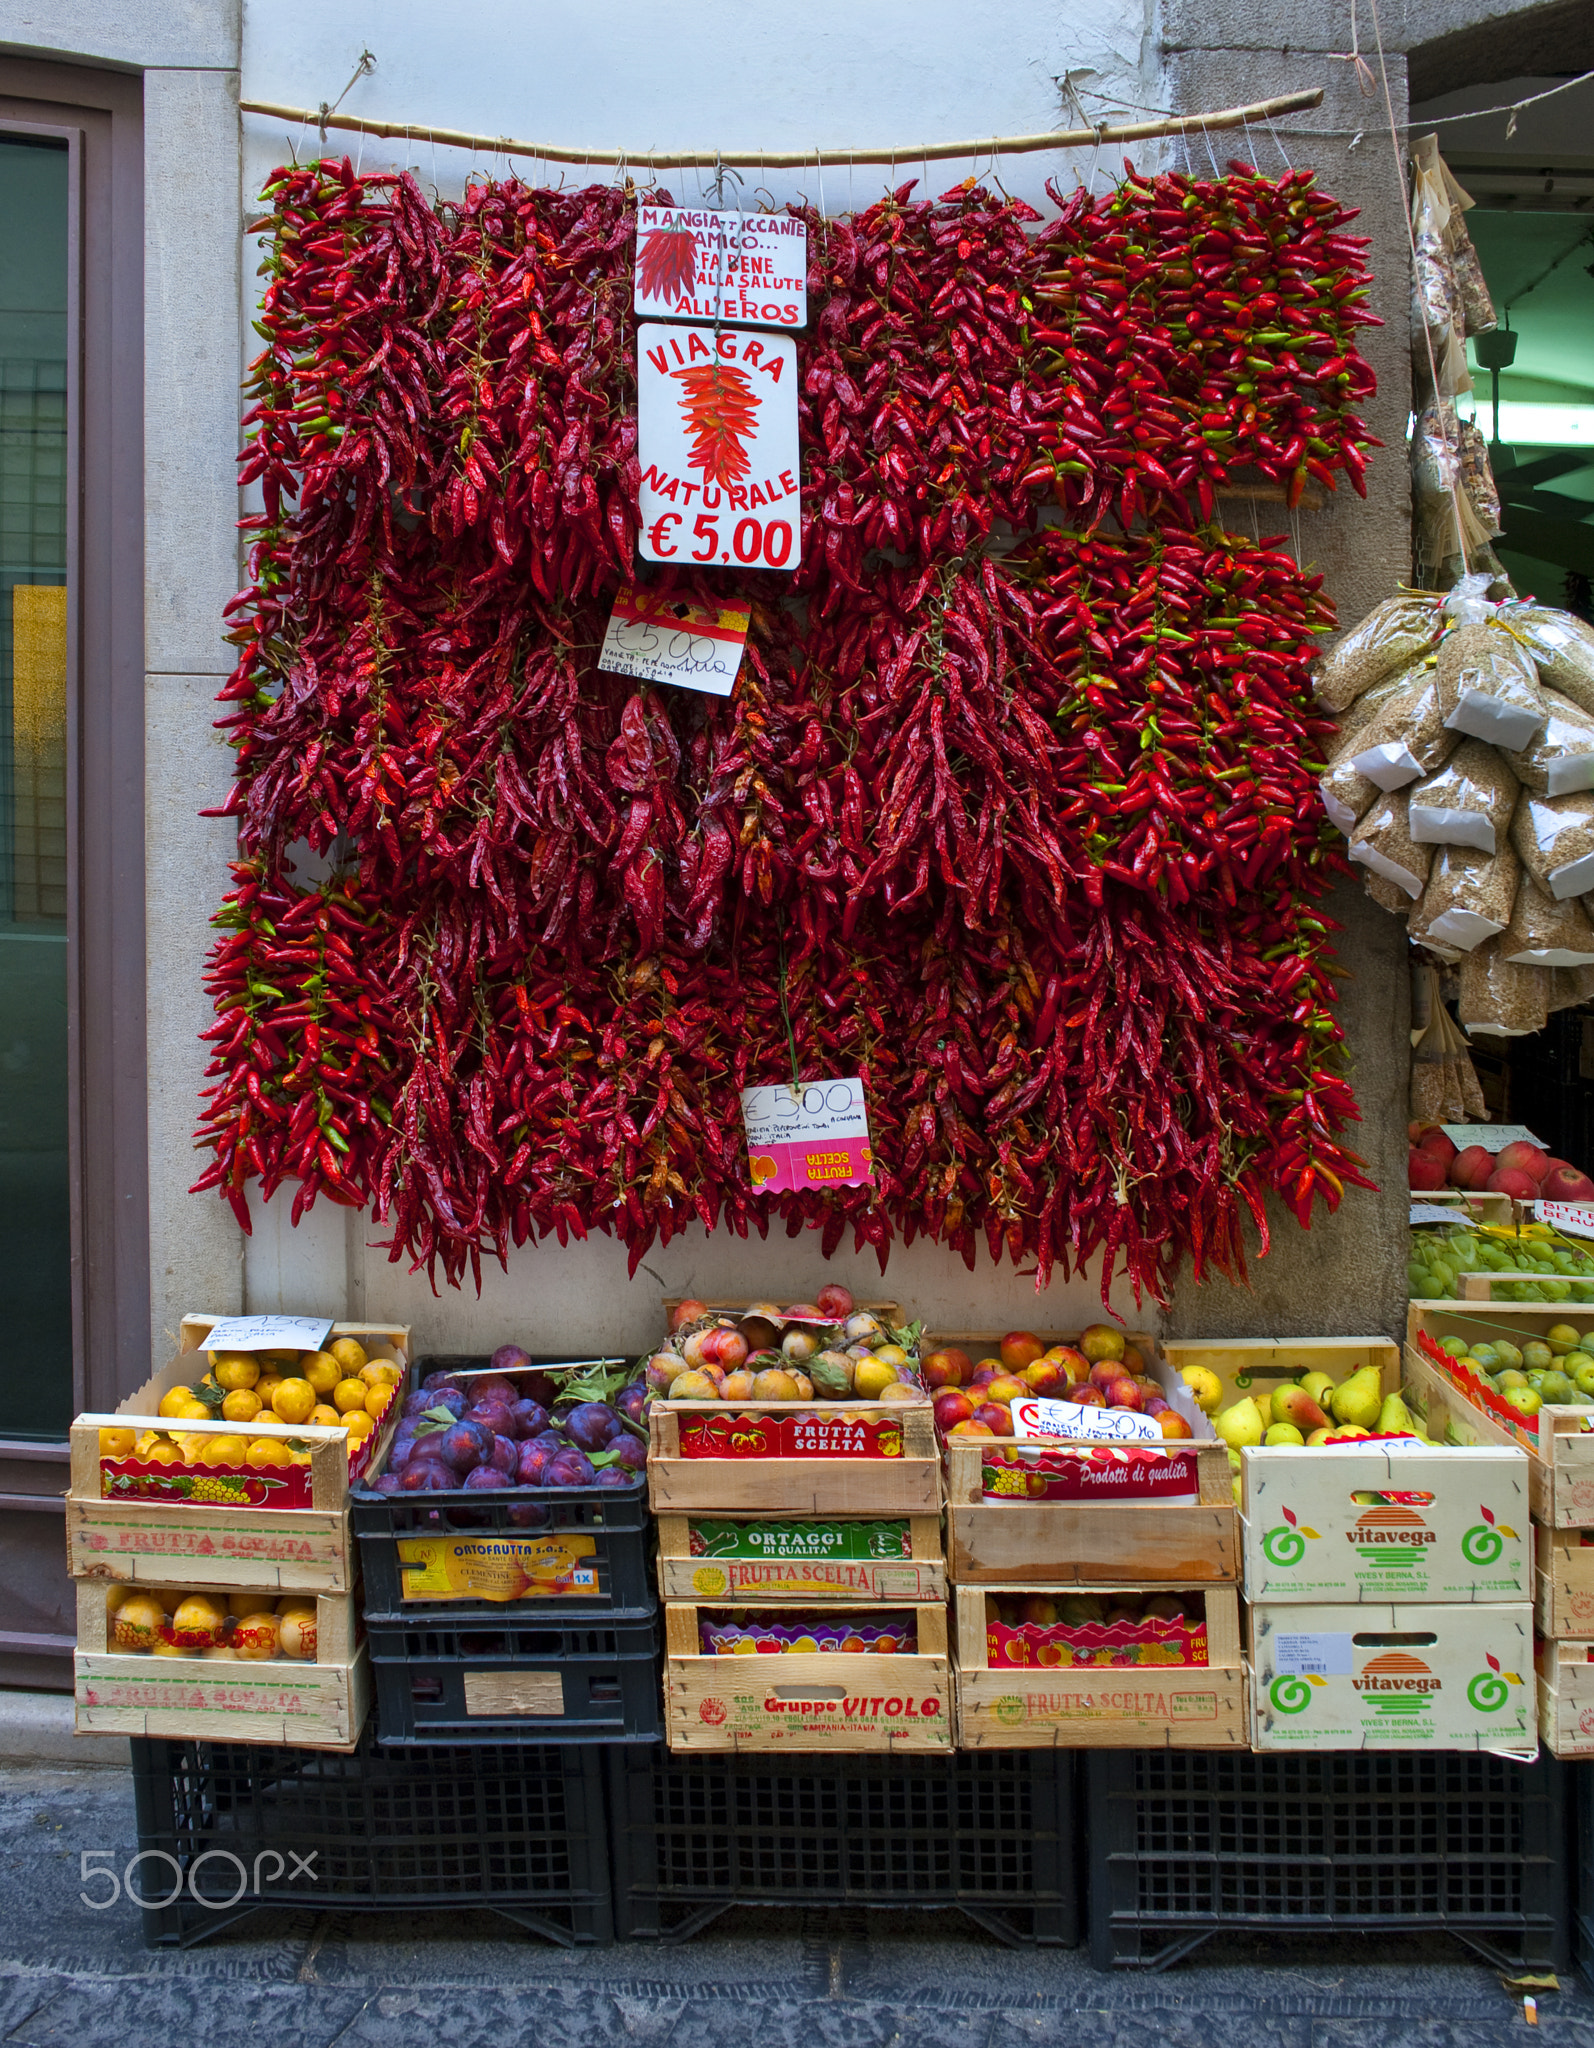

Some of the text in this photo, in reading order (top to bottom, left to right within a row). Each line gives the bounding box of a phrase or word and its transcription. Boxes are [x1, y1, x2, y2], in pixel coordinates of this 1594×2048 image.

[642, 208, 721, 229] MANGIA
[728, 254, 774, 275] BENE
[696, 272, 804, 292] ALLA SALUTE
[739, 289, 747, 301] E
[675, 296, 799, 325] ALL'EROS
[646, 333, 785, 383] VIAGRA
[641, 463, 799, 512] NATURALE
[647, 512, 793, 568] € 5,00
[806, 1152, 849, 1166] SCELTA
[807, 1166, 853, 1181] FRUTTA
[793, 1425, 866, 1438] FRUTTA
[795, 1438, 865, 1451] SCELTA
[1080, 1461, 1188, 1487] Prodotti di qualità
[118, 1532, 313, 1555] FRUTTA SCELTA
[748, 1532, 843, 1546] ORTAGGI
[1346, 1527, 1437, 1546] vitavega
[453, 1544, 532, 1557] ORTOFRUTTA
[762, 1545, 832, 1556] DI QUALITA'
[575, 1574, 591, 1583] 1X
[728, 1565, 798, 1588] FRUTTA
[801, 1565, 870, 1590] SCELTA
[1354, 1571, 1379, 1579] VIVES
[1351, 1674, 1442, 1693] vitavega
[764, 1697, 941, 1717] Gruppo VITOLO
[1026, 1692, 1096, 1718] FRUTTA
[1100, 1692, 1169, 1716] SCELTA
[1360, 1718, 1384, 1726] VIVES
